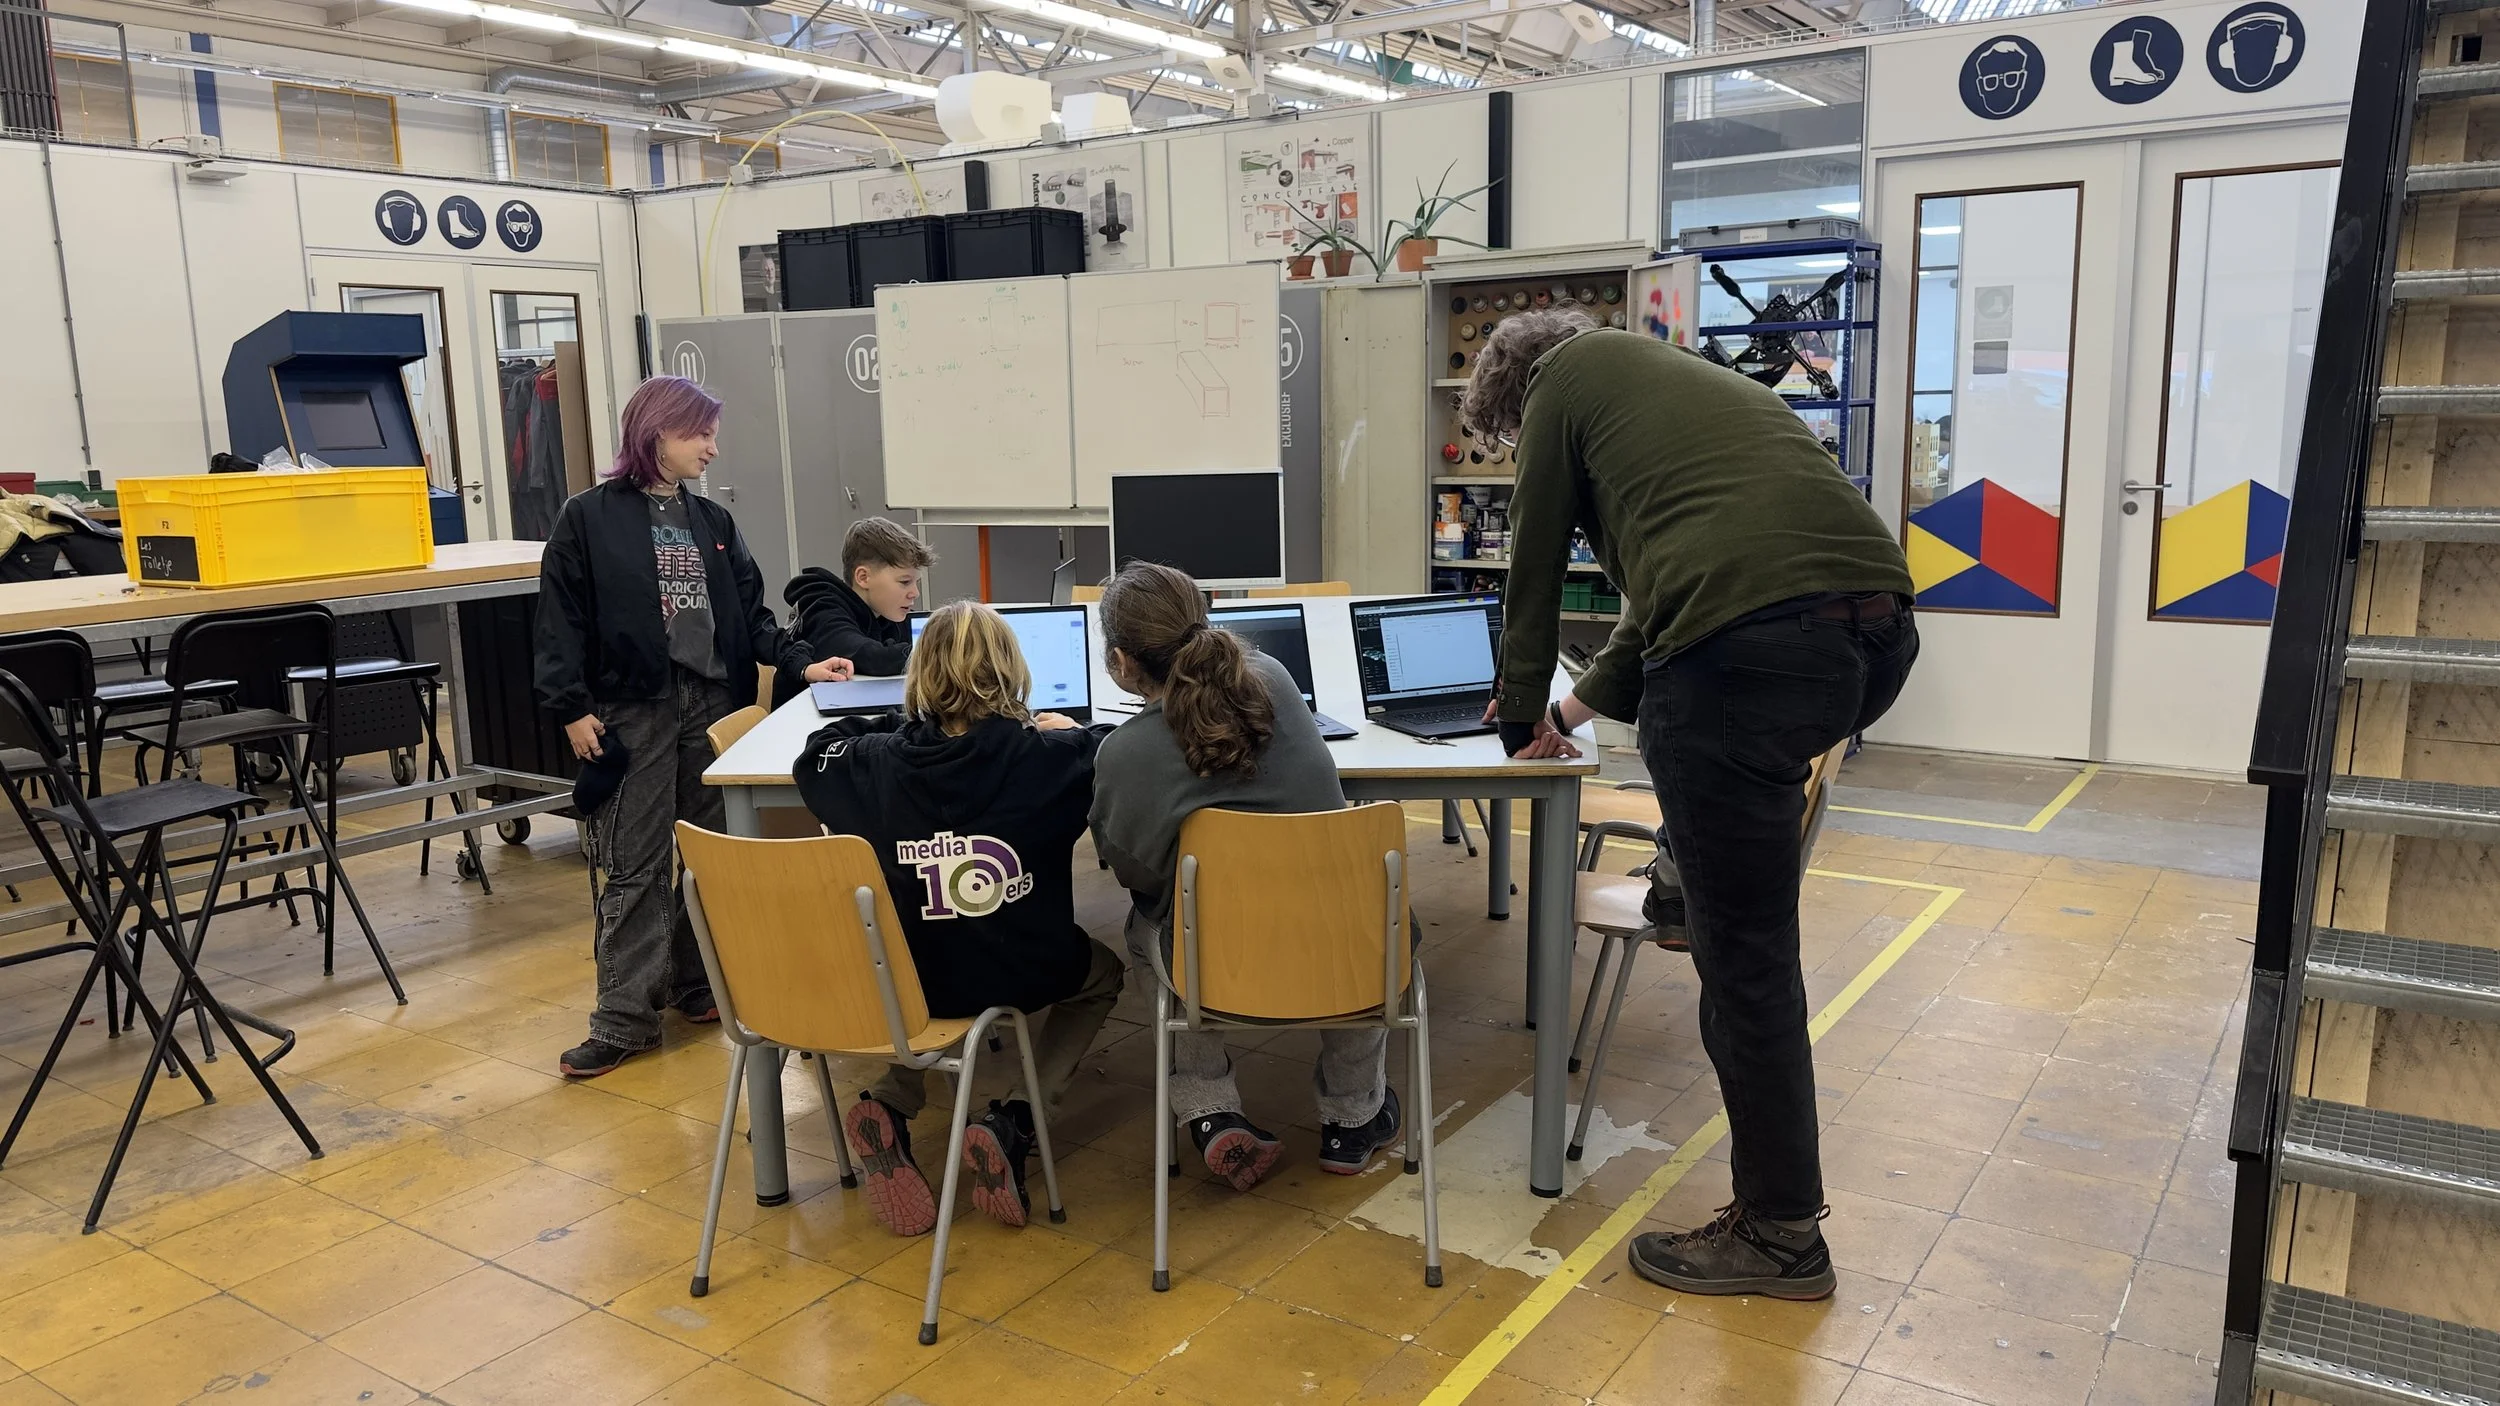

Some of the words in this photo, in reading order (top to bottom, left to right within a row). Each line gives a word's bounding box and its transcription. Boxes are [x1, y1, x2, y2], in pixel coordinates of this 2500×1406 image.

[1332, 137, 1355, 146] Copper
[1241, 183, 1357, 202] CONCEPTFASE
[1280, 327, 1293, 367] 5
[680, 351, 698, 382] 01
[854, 346, 880, 381] 02
[1281, 392, 1292, 447] EXCLUSIEF
[141, 538, 152, 551] Les
[659, 580, 707, 594] MERICA
[671, 595, 707, 609] TOUR
[899, 836, 966, 860] media
